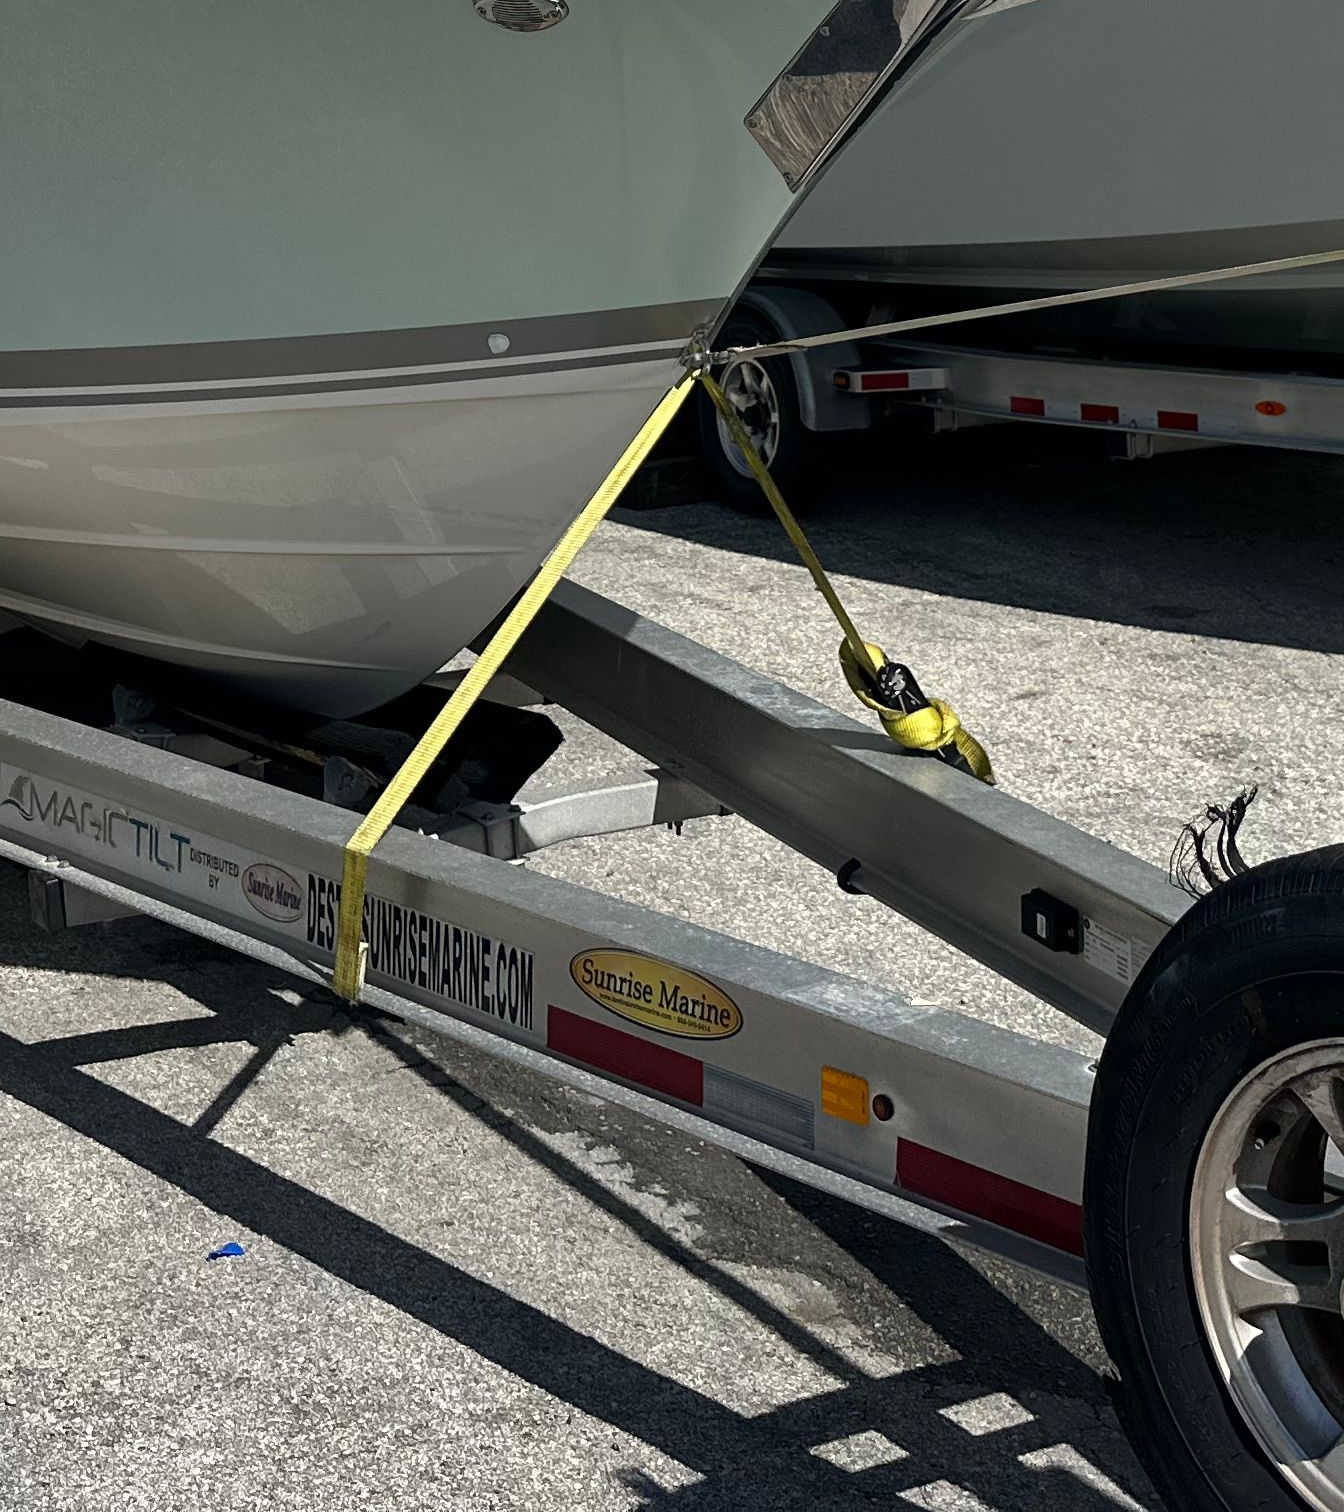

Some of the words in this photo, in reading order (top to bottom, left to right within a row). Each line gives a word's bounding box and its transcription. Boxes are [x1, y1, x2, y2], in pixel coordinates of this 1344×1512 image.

[189, 847, 240, 878] DISTRIBUTED
[208, 873, 220, 889] BY
[581, 957, 653, 1004] Sunrise
[658, 979, 732, 1029] Marine
